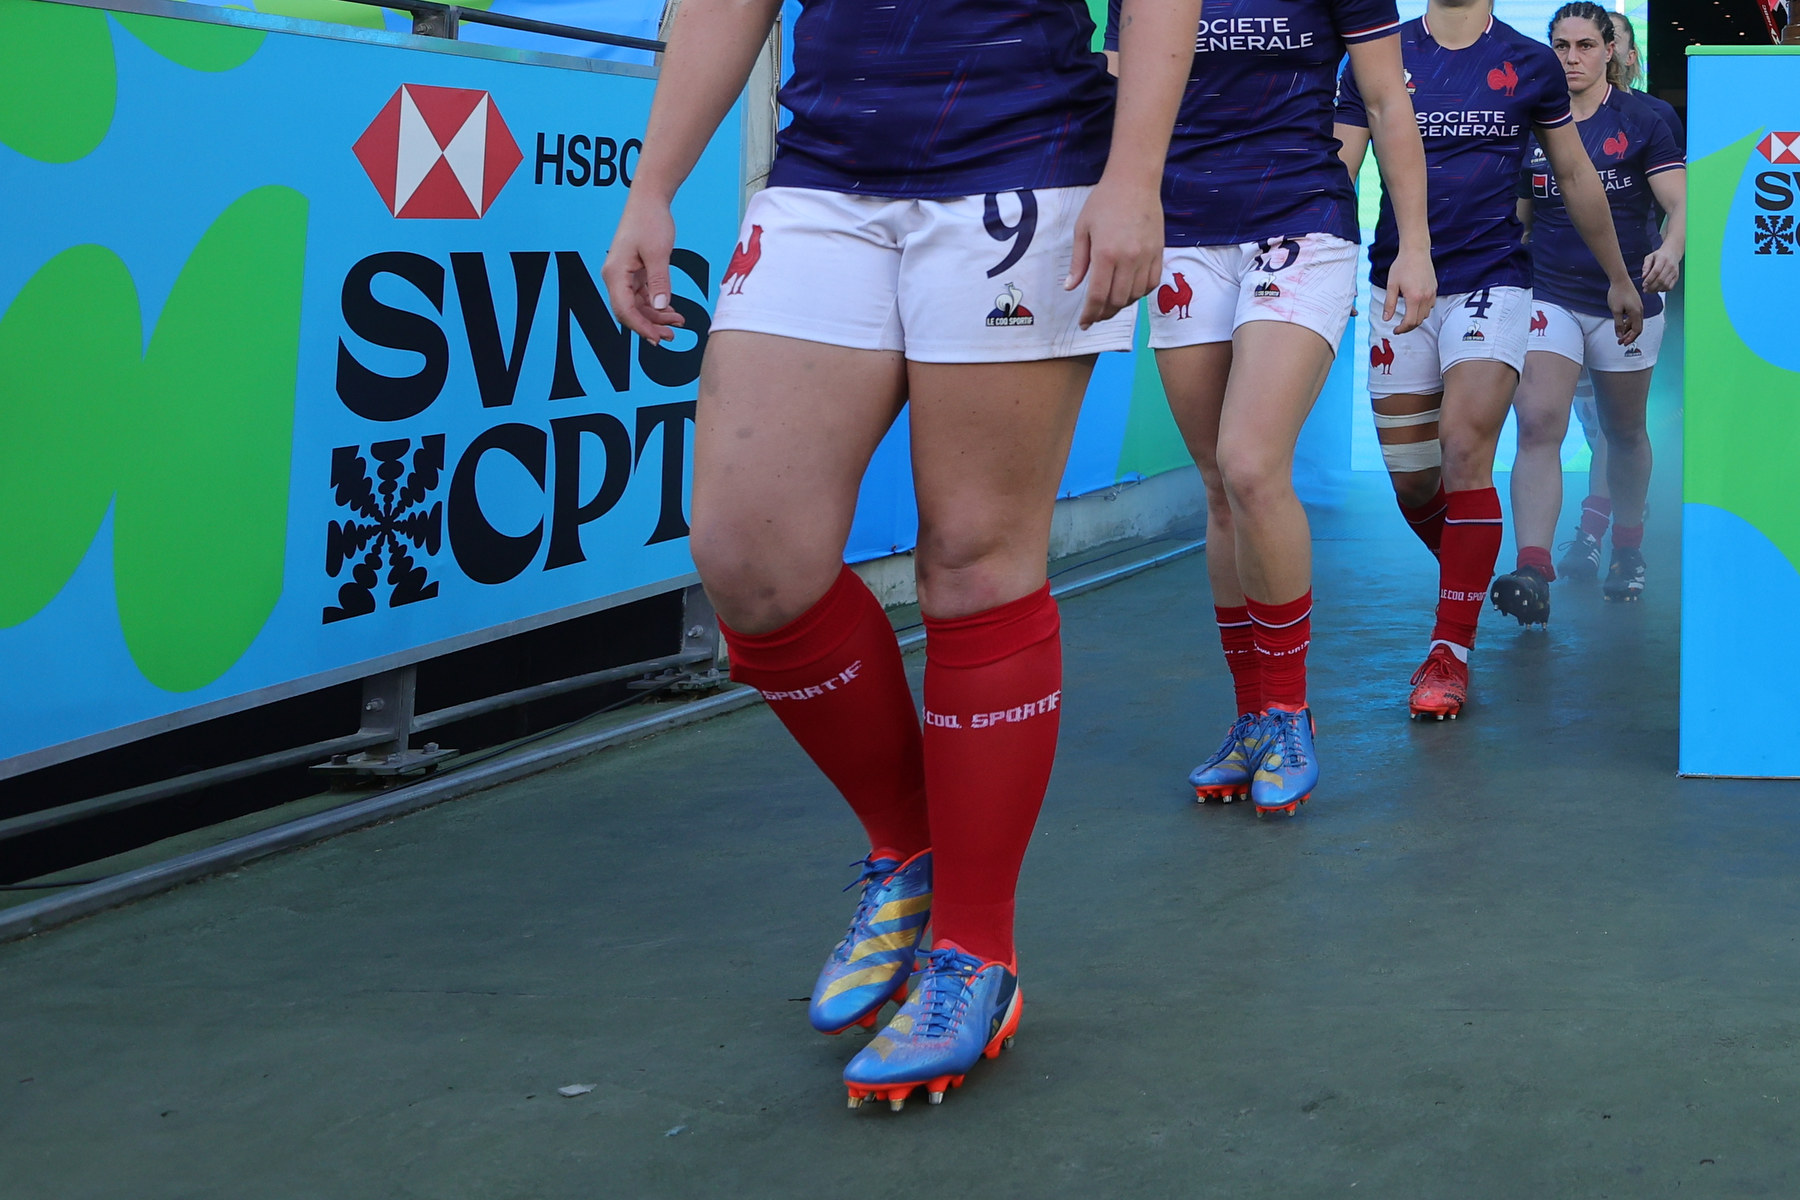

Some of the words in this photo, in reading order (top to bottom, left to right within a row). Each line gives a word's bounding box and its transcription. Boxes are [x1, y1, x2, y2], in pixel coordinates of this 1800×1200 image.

[1195, 32, 1314, 53] ENERALE
[1197, 17, 1291, 35] OCIETE
[1415, 111, 1506, 123] SOCIETE
[983, 192, 1038, 279] 9
[1009, 316, 1033, 325] SPORTIF
[1464, 288, 1493, 319] 4
[336, 248, 711, 422] SVNS
[448, 400, 698, 585] CPT
[762, 660, 862, 701] SPORTIF
[926, 711, 962, 729] COQ
[971, 690, 1061, 729] SPORTIF
